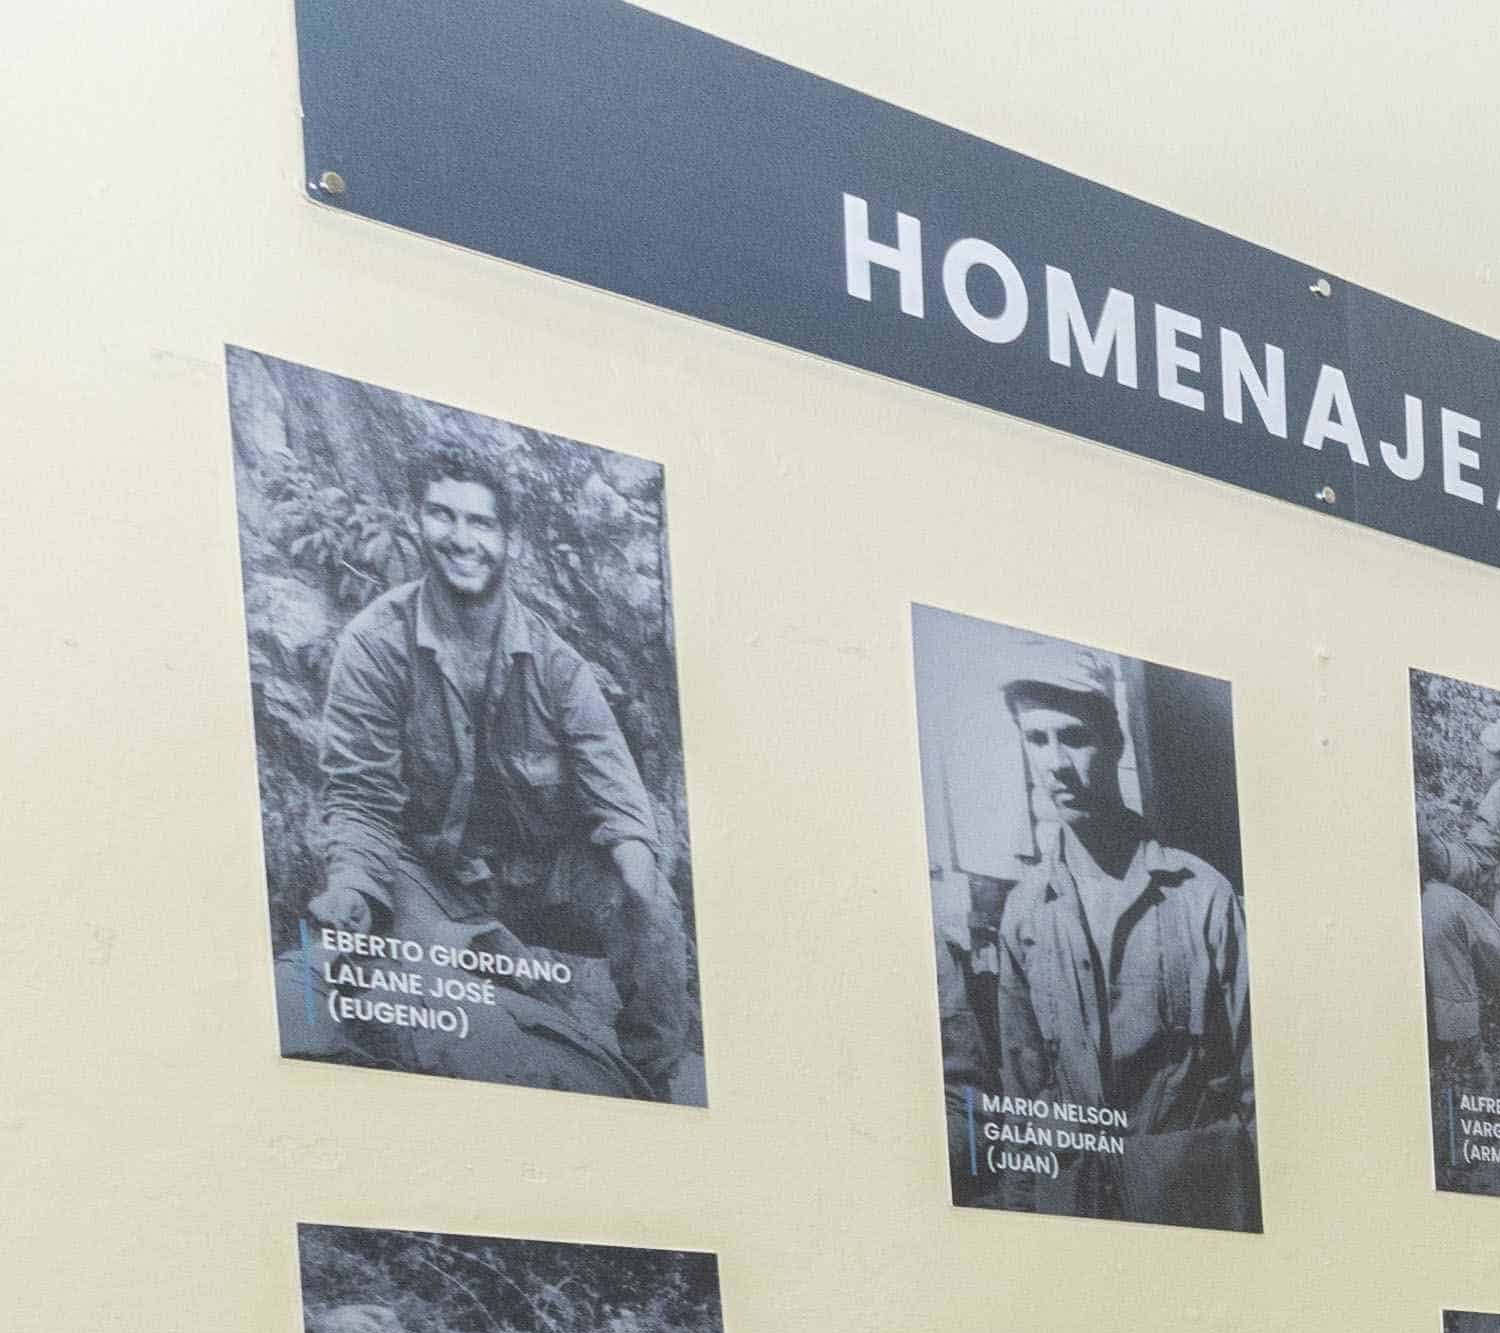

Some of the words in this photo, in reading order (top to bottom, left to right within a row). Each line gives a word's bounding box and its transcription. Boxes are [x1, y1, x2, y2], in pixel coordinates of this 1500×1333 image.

[321, 927, 424, 963] EBERTO
[429, 945, 572, 984] GIORDANO
[323, 961, 424, 996] LALANE
[429, 977, 497, 1005] JOSÉ
[328, 990, 469, 1038] (EUGENIO)
[982, 1093, 1050, 1119] MARIO
[1053, 1101, 1128, 1128] NELSON
[984, 1121, 1052, 1147] GALÁN
[1056, 1130, 1125, 1155] DURÁN
[987, 1145, 1059, 1179] (JUAN)
